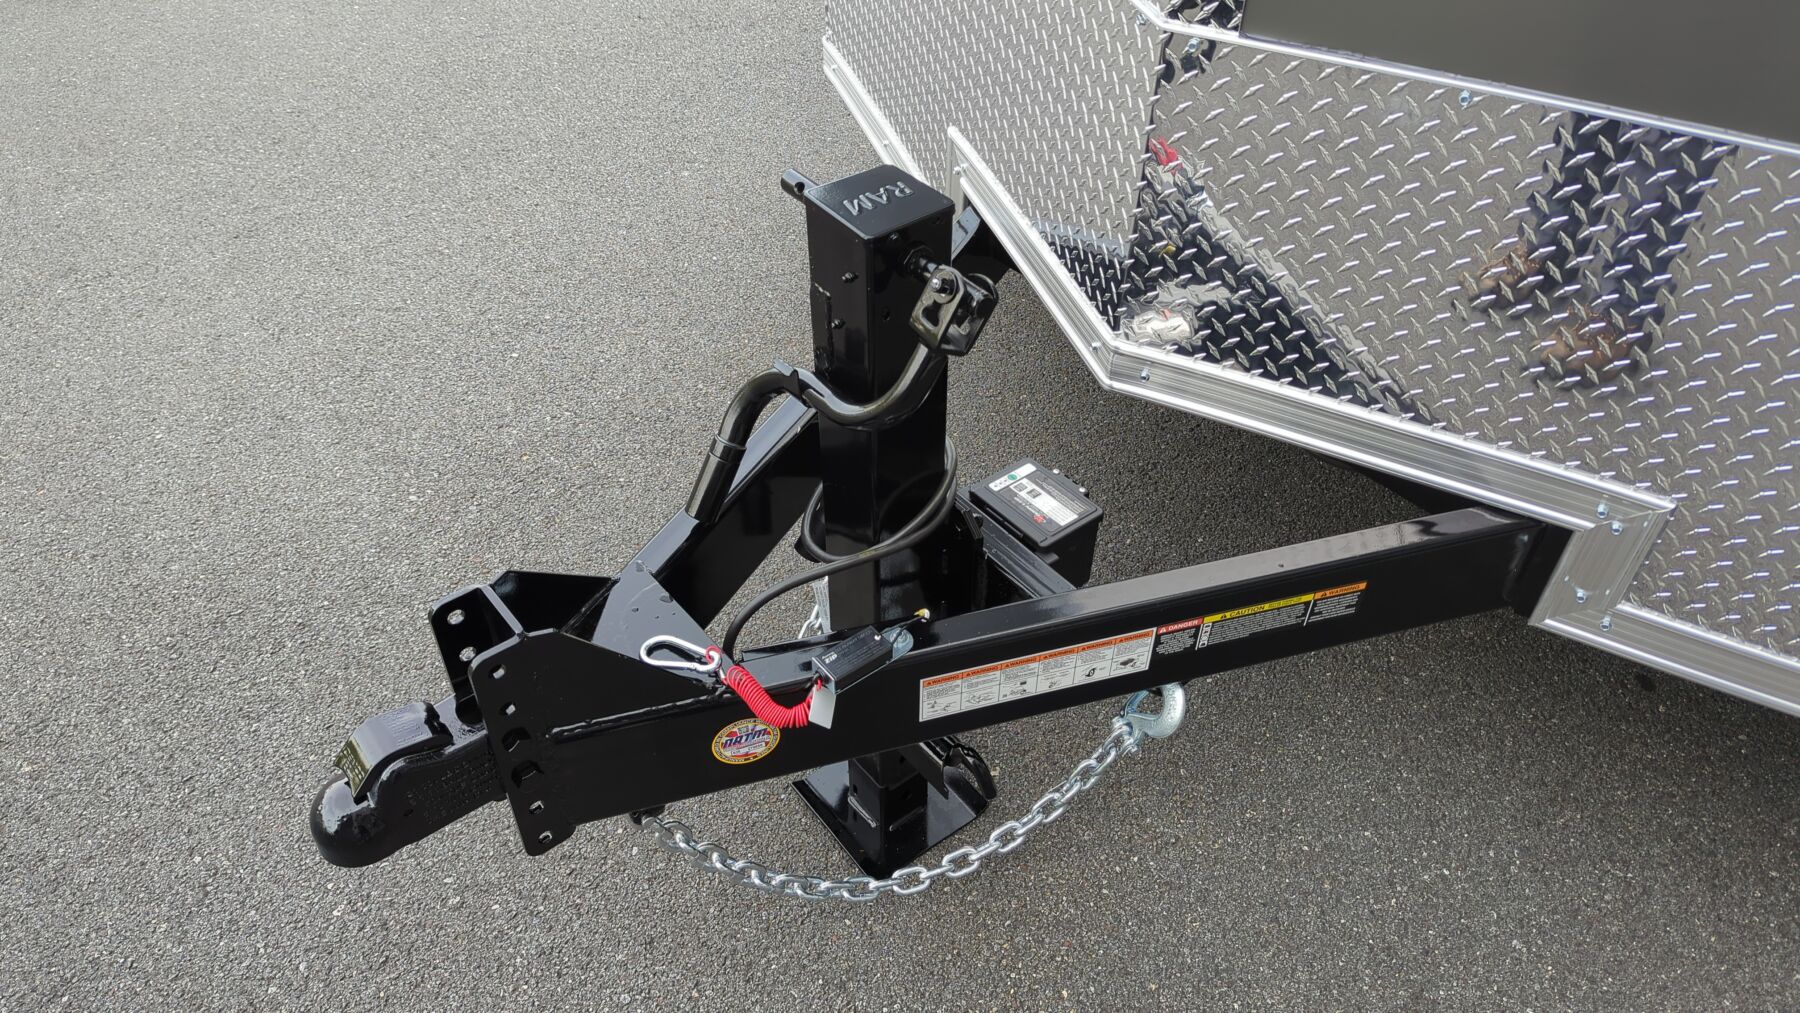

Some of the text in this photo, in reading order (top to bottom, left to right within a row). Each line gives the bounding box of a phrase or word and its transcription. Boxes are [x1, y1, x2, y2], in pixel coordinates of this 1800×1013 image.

[843, 181, 914, 216] RAM
[1329, 585, 1361, 595] WARNING
[1230, 604, 1265, 618] CAUTION
[1168, 620, 1199, 631] DANGER
[1124, 632, 1151, 642] WARNING
[1086, 640, 1113, 650] WARNING
[1048, 649, 1075, 659] WARNING
[1010, 657, 1037, 667] WARNING
[971, 666, 999, 676] WARNING
[932, 674, 960, 685] WARNING
